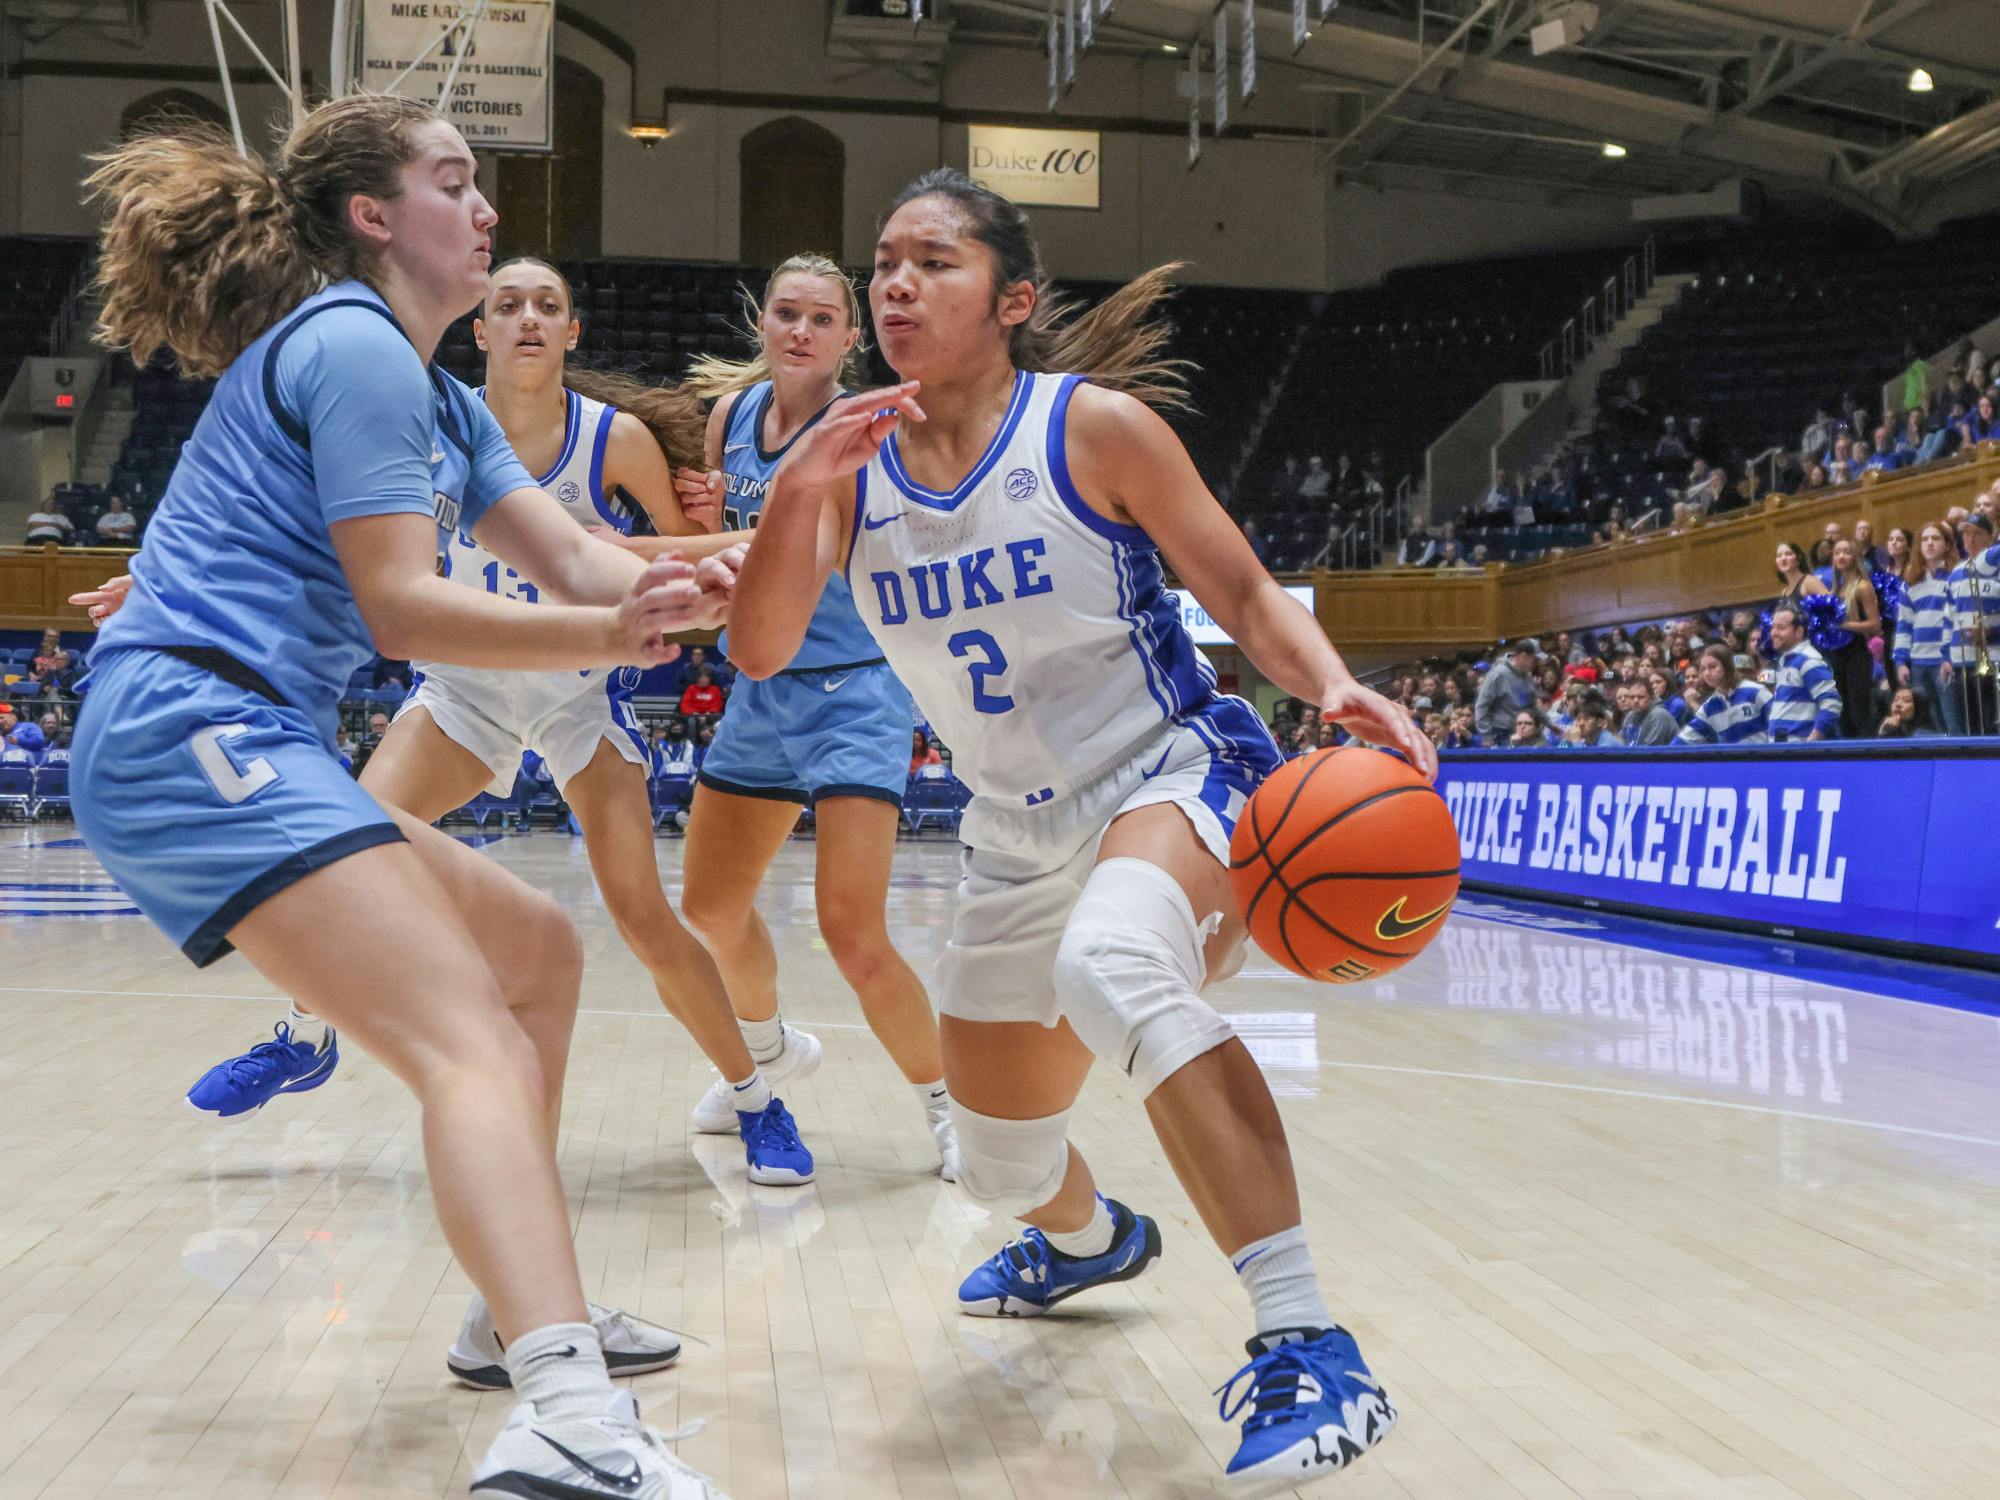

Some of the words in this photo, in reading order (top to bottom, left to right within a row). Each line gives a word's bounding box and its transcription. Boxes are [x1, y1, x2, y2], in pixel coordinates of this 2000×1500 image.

[391, 4, 429, 17] MIKE
[367, 60, 393, 70] NCAA
[484, 65, 543, 77] BASKETBALL
[451, 101, 523, 116] VICTORIES
[483, 125, 507, 135] 2011
[972, 146, 1038, 171] Duke
[1042, 149, 1096, 175] 100
[871, 538, 1053, 625] DUKE
[947, 629, 1015, 714] 2
[191, 722, 280, 804] C
[1446, 781, 1529, 865] DUKE
[1530, 784, 1846, 903] BASKETBALL
